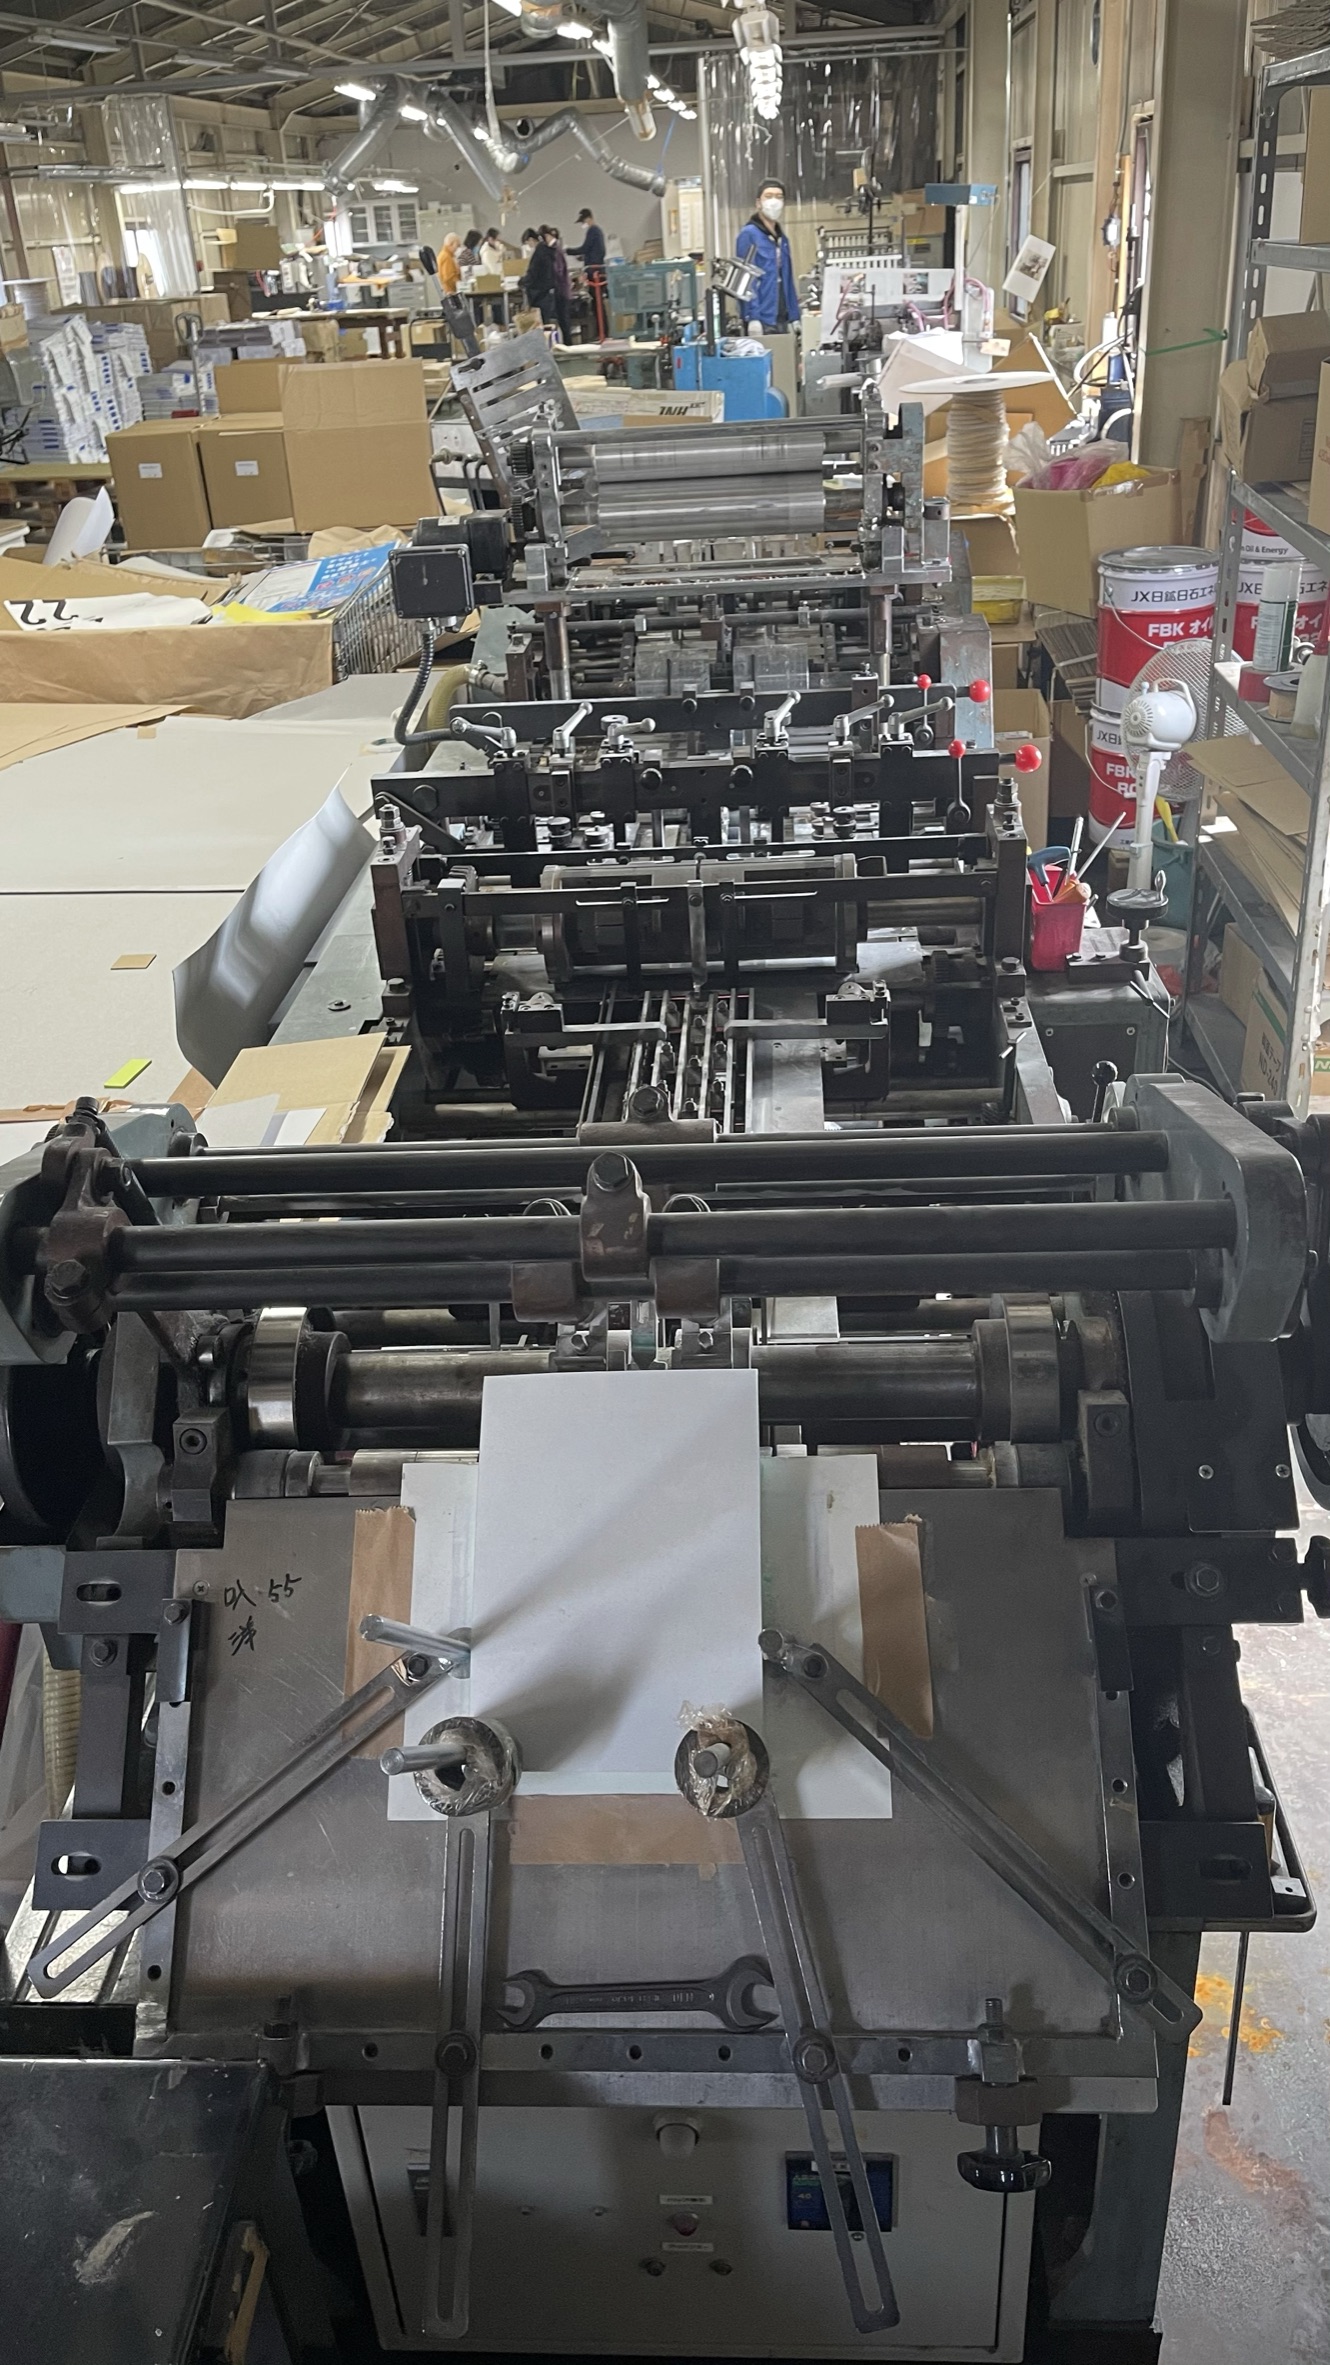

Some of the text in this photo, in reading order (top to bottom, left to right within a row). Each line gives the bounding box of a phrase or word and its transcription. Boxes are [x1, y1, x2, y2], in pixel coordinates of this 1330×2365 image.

[1261, 546, 1289, 555] Energy
[1147, 621, 1185, 637] FBK
[268, 1573, 302, 1603] 55
